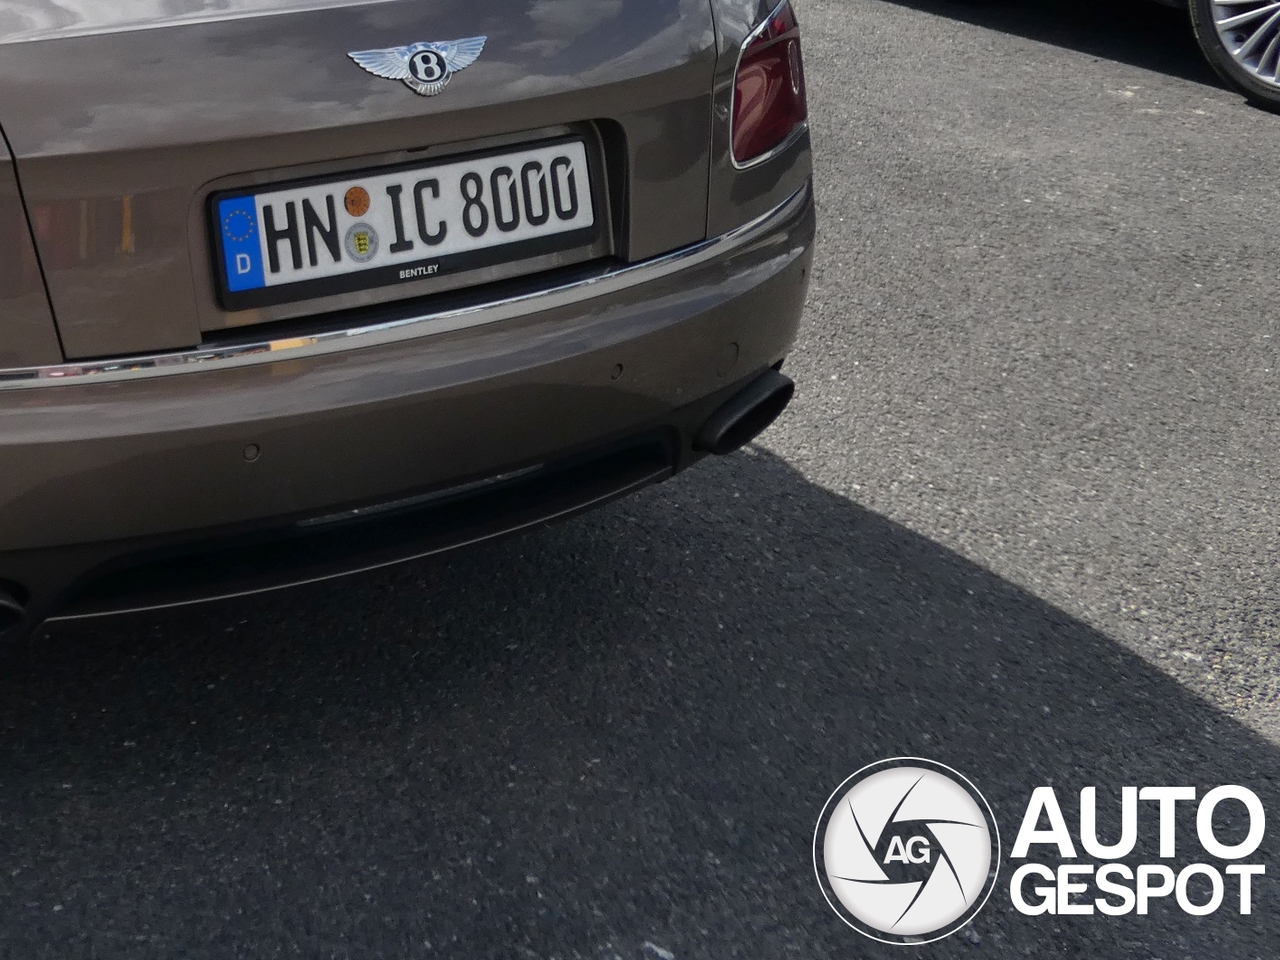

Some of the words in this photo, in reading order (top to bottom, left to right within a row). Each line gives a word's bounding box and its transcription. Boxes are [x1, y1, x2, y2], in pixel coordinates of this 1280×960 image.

[413, 52, 442, 80] B
[262, 194, 342, 274] HN
[385, 178, 448, 254] IC
[460, 156, 580, 238] 8000
[235, 253, 252, 275] D
[399, 264, 439, 279] BENTLEY
